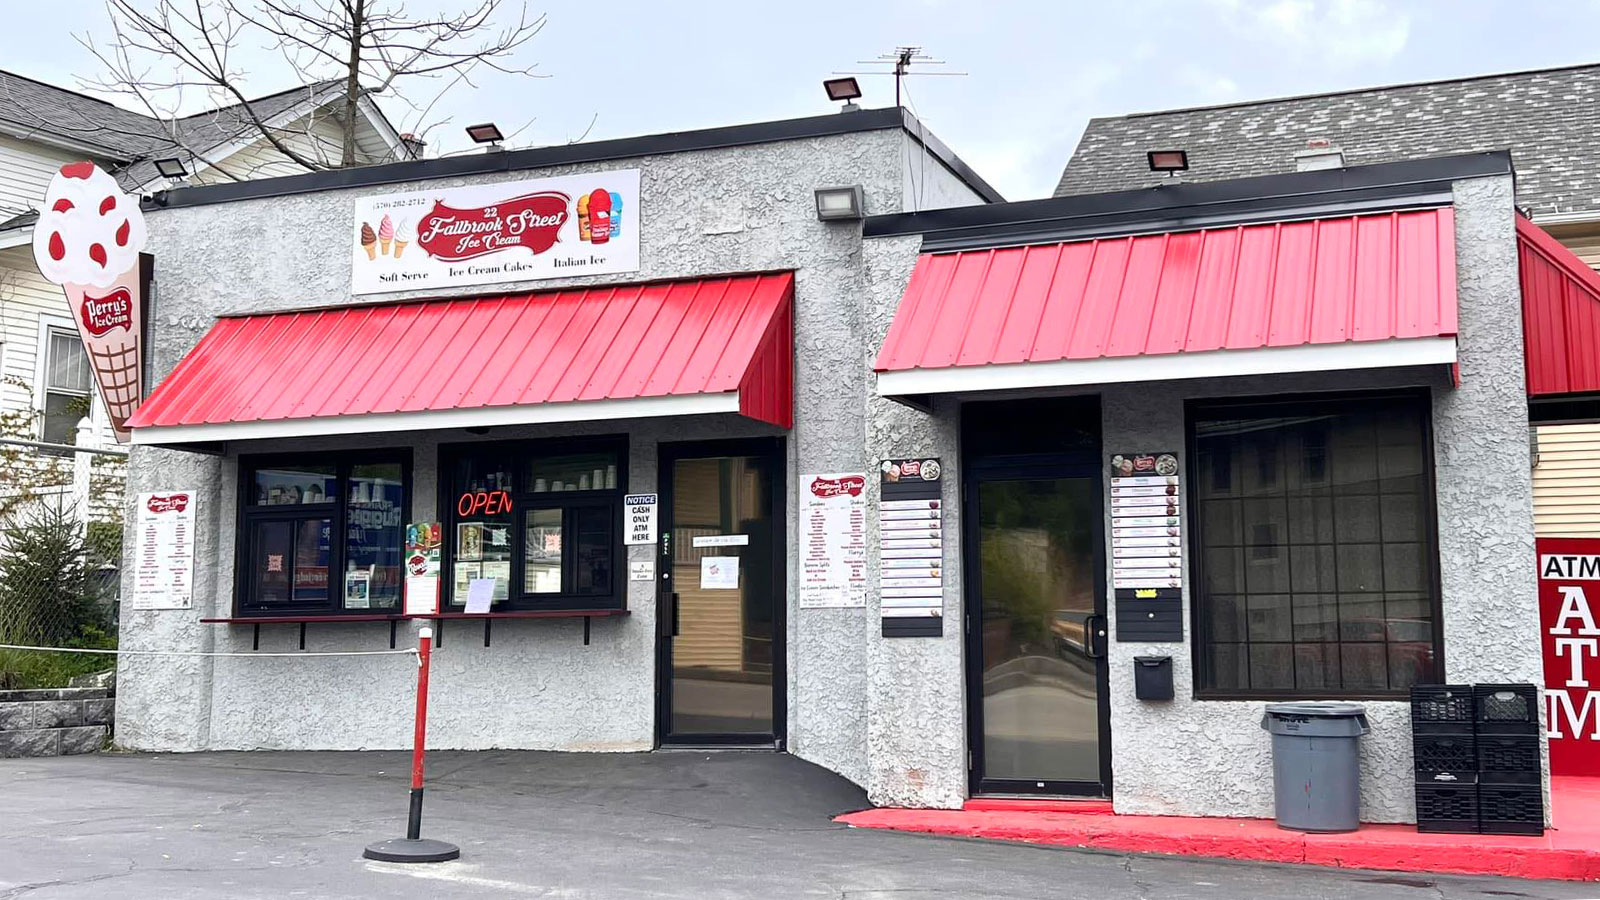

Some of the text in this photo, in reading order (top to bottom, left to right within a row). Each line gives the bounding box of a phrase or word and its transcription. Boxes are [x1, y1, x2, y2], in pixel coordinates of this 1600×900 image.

[484, 207, 498, 218] 22
[421, 215, 503, 243] Fallbrook
[506, 208, 564, 235] Street
[456, 232, 521, 254] Ice Cream
[553, 255, 606, 268] Italian Ice
[449, 261, 533, 277] Ice Cream Cakes
[379, 271, 429, 283] Soft Serve
[85, 296, 128, 325] Perry's
[458, 491, 513, 517] OPEN
[627, 495, 656, 505] NOTICE
[632, 506, 651, 514] CASH
[632, 515, 650, 523] ONLY
[633, 524, 648, 532] ATM
[632, 533, 650, 541] HERE
[1544, 556, 1600, 578] ATM
